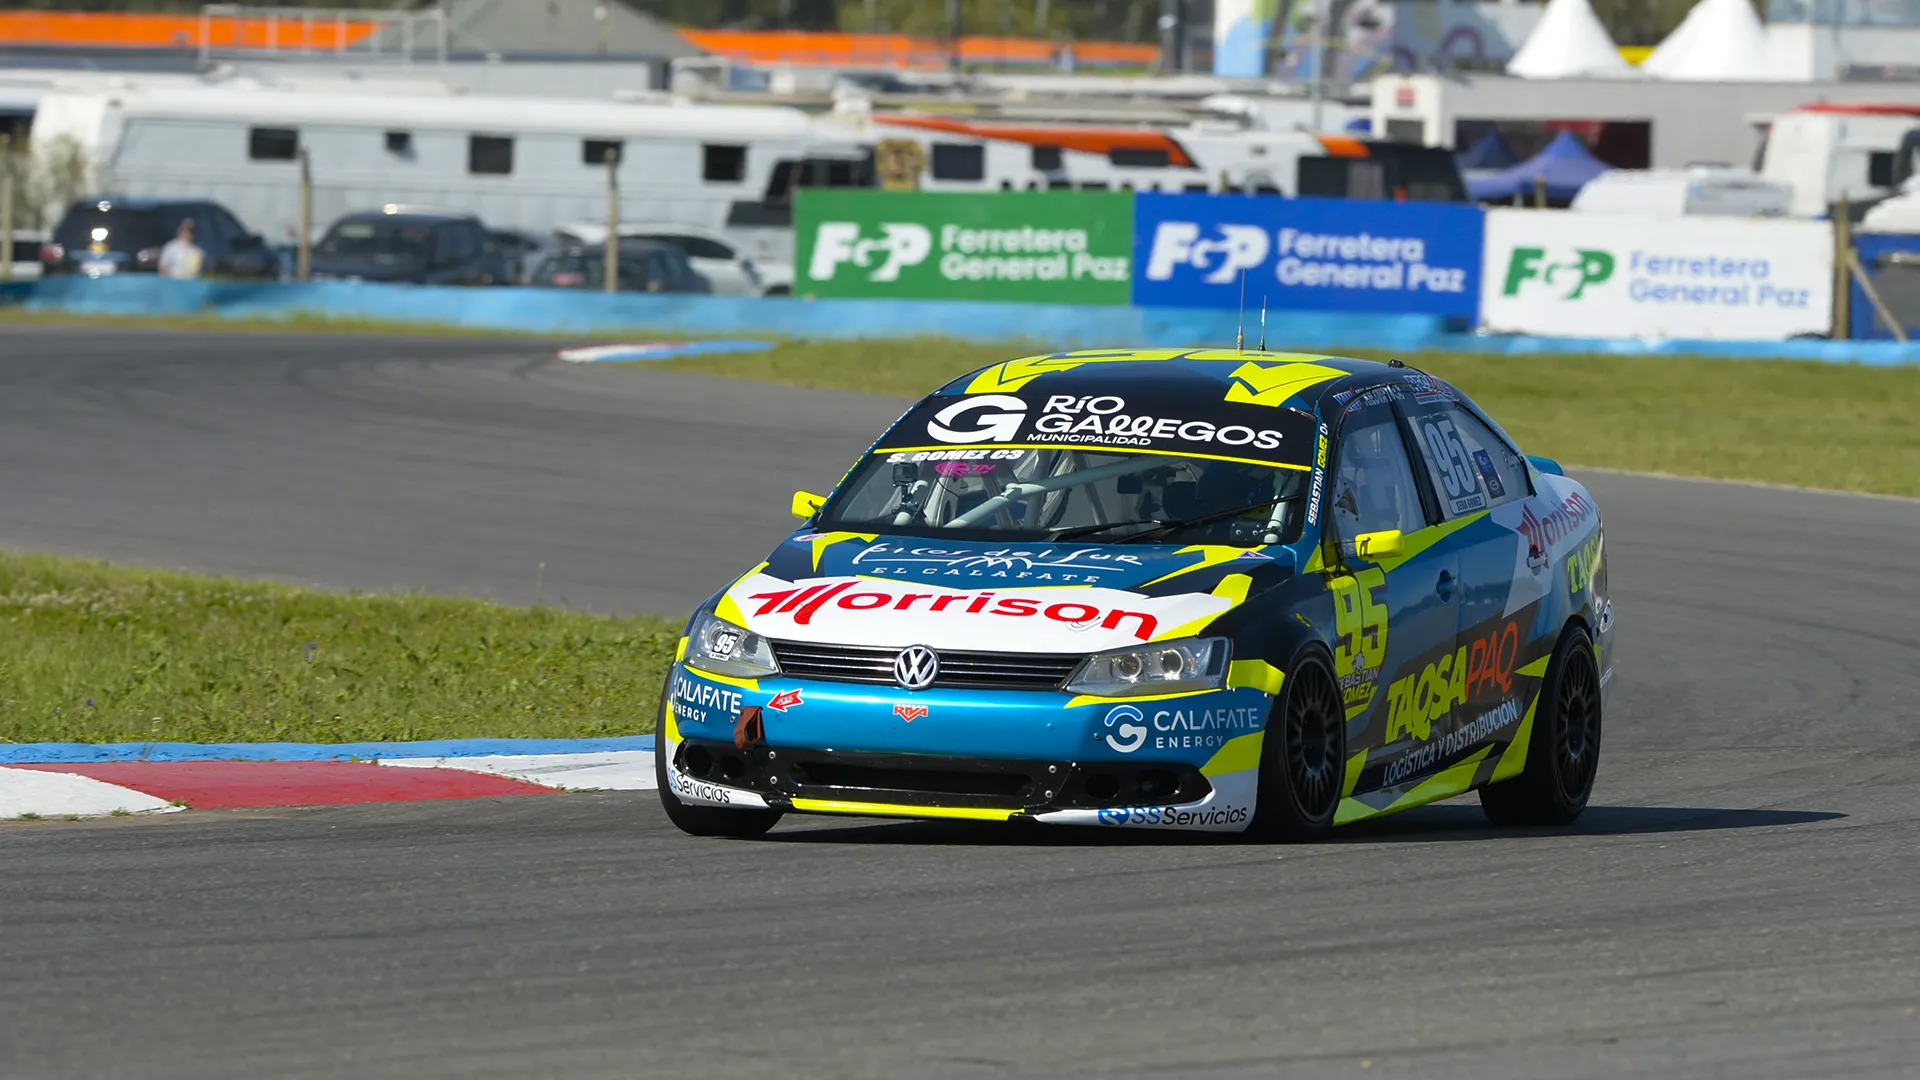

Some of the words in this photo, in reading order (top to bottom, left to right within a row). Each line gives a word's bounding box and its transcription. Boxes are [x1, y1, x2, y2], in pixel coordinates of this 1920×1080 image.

[940, 224, 1087, 252] Ferretera
[1278, 228, 1424, 261] Ferretera
[939, 252, 1068, 280] General
[1072, 253, 1131, 281] Paz
[1276, 257, 1402, 290] General
[1407, 264, 1466, 292] Paz
[1628, 250, 1770, 278] Ferretera
[1628, 279, 1749, 306] General
[1756, 286, 1810, 307] Paz
[1026, 433, 1152, 446] MUNICIPALIDAD
[911, 451, 985, 461] GOMEZ
[990, 450, 1025, 460] C3
[1424, 420, 1476, 497] 95
[1307, 467, 1324, 526] SEBASTIAN
[1317, 434, 1328, 468] GOMEZ
[1515, 491, 1594, 569] Morrison
[921, 568, 1100, 583] CALAFATE
[748, 580, 1158, 642] Morrison
[1333, 566, 1389, 678] 95
[713, 633, 737, 654] 95
[677, 676, 743, 714] CALAFATE
[1153, 707, 1260, 731] CALAFATE
[1155, 735, 1224, 749] ENERGY
[1382, 743, 1435, 788] LOGÍSTICA
[1437, 739, 1446, 762] Y
[1445, 698, 1517, 757] DISTRIBUCIÓN
